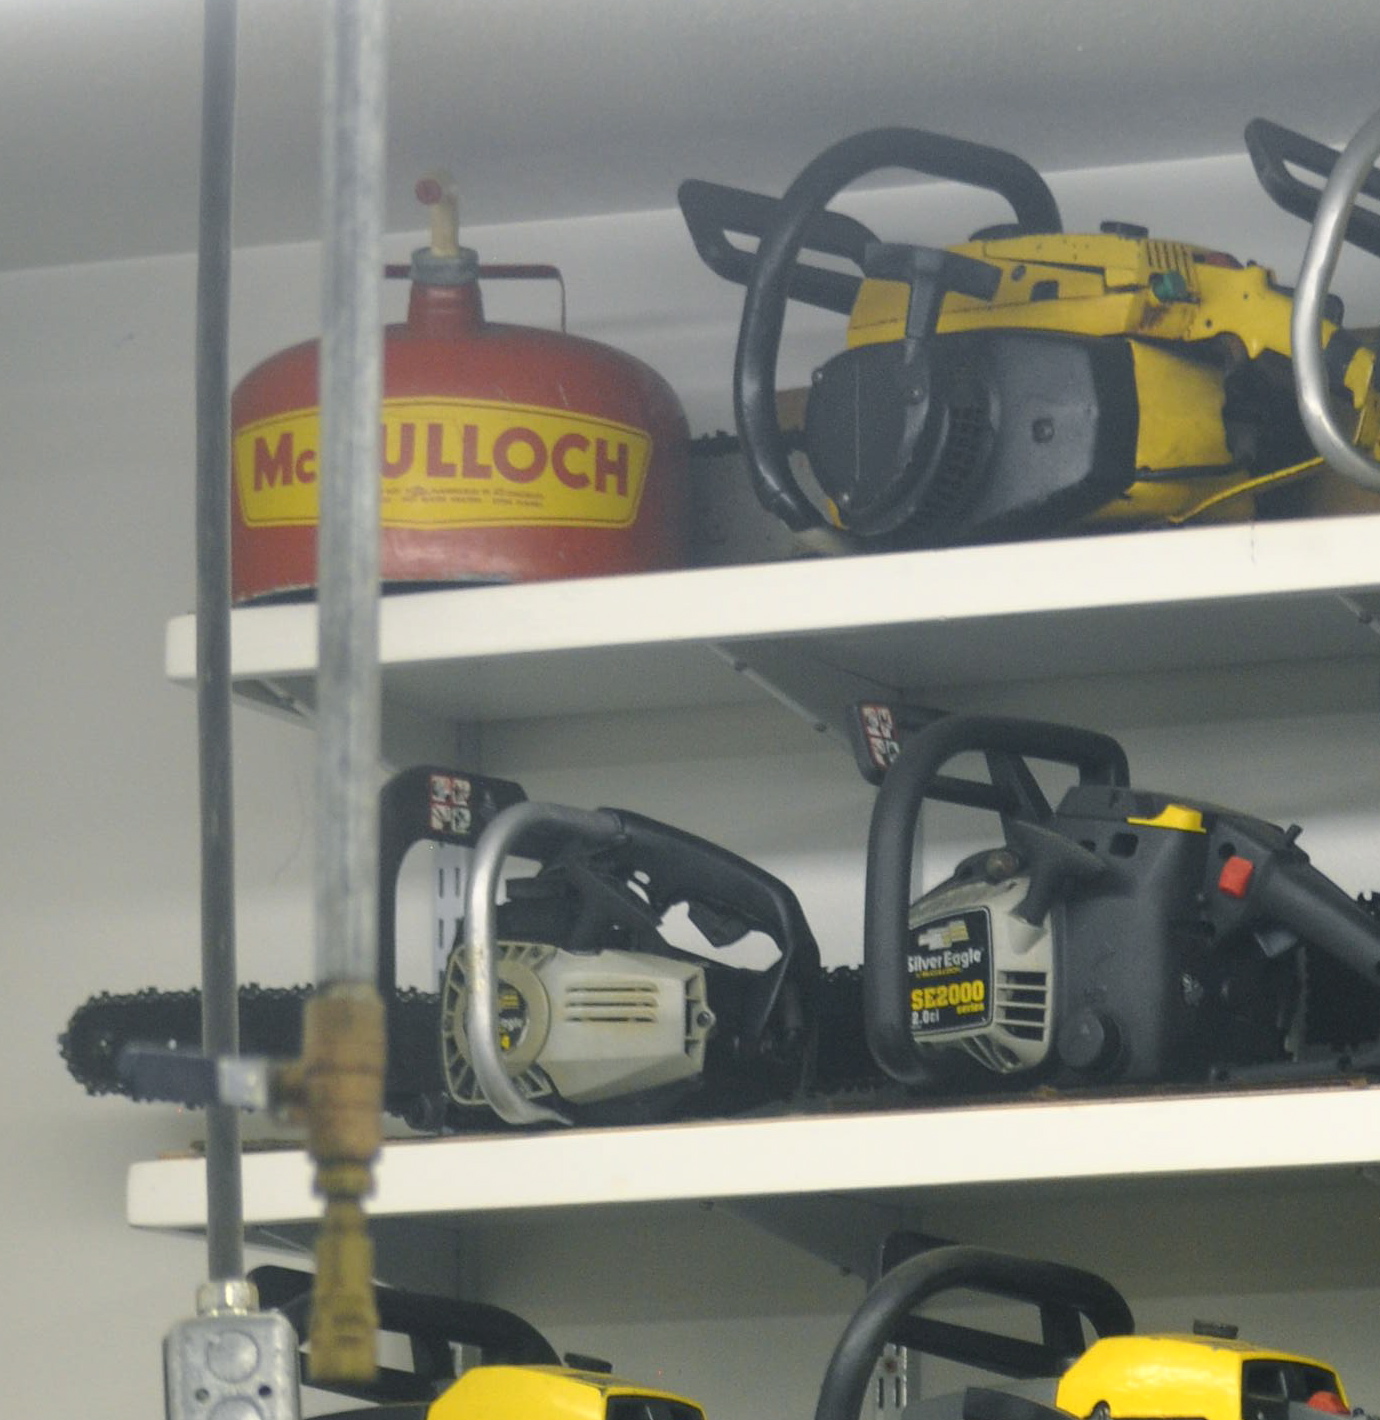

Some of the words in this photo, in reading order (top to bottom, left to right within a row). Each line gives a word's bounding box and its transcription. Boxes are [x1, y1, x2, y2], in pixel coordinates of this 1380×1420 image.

[252, 422, 630, 498] McULLOCH
[907, 955, 943, 973] Silver
[943, 947, 983, 969] Eagle
[910, 979, 986, 1012] SE2000
